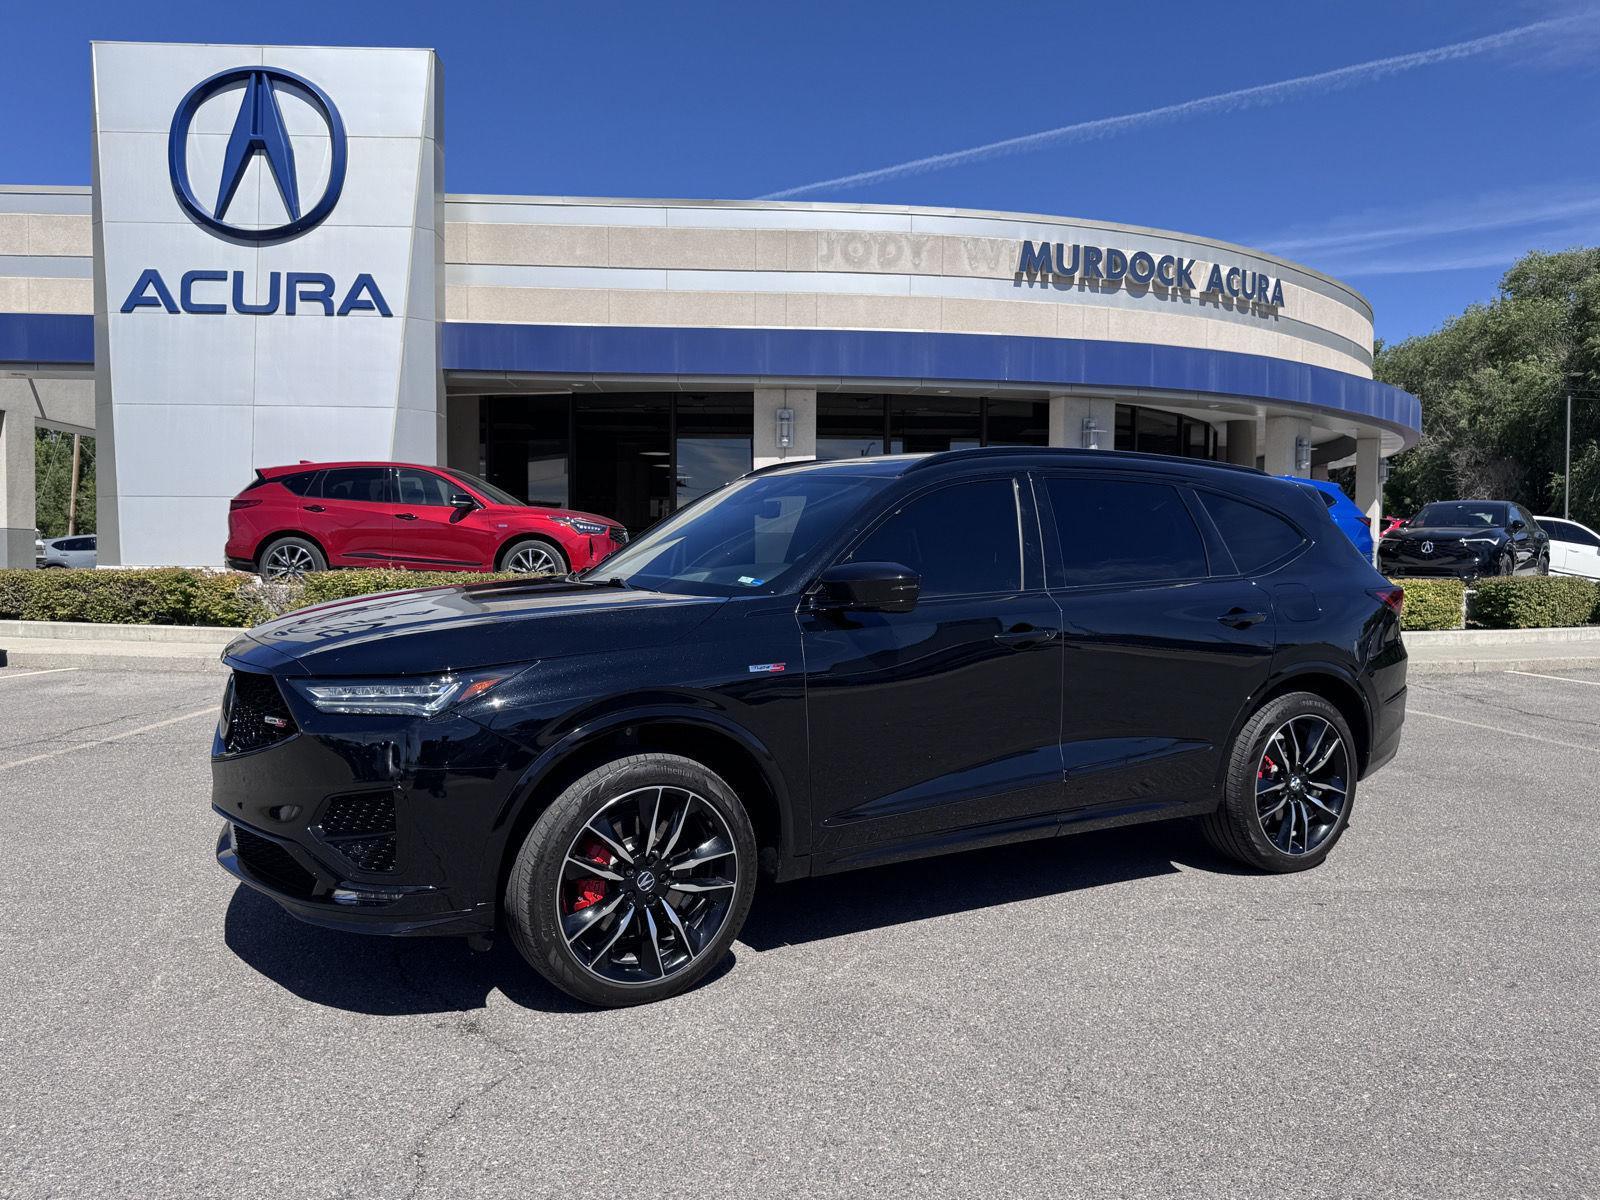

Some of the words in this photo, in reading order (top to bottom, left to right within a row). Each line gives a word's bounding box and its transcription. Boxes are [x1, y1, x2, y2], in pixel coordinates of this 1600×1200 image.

[120, 268, 394, 317] ACURA
[1018, 240, 1196, 289] MURDOCK
[1206, 263, 1285, 307] ACURA
